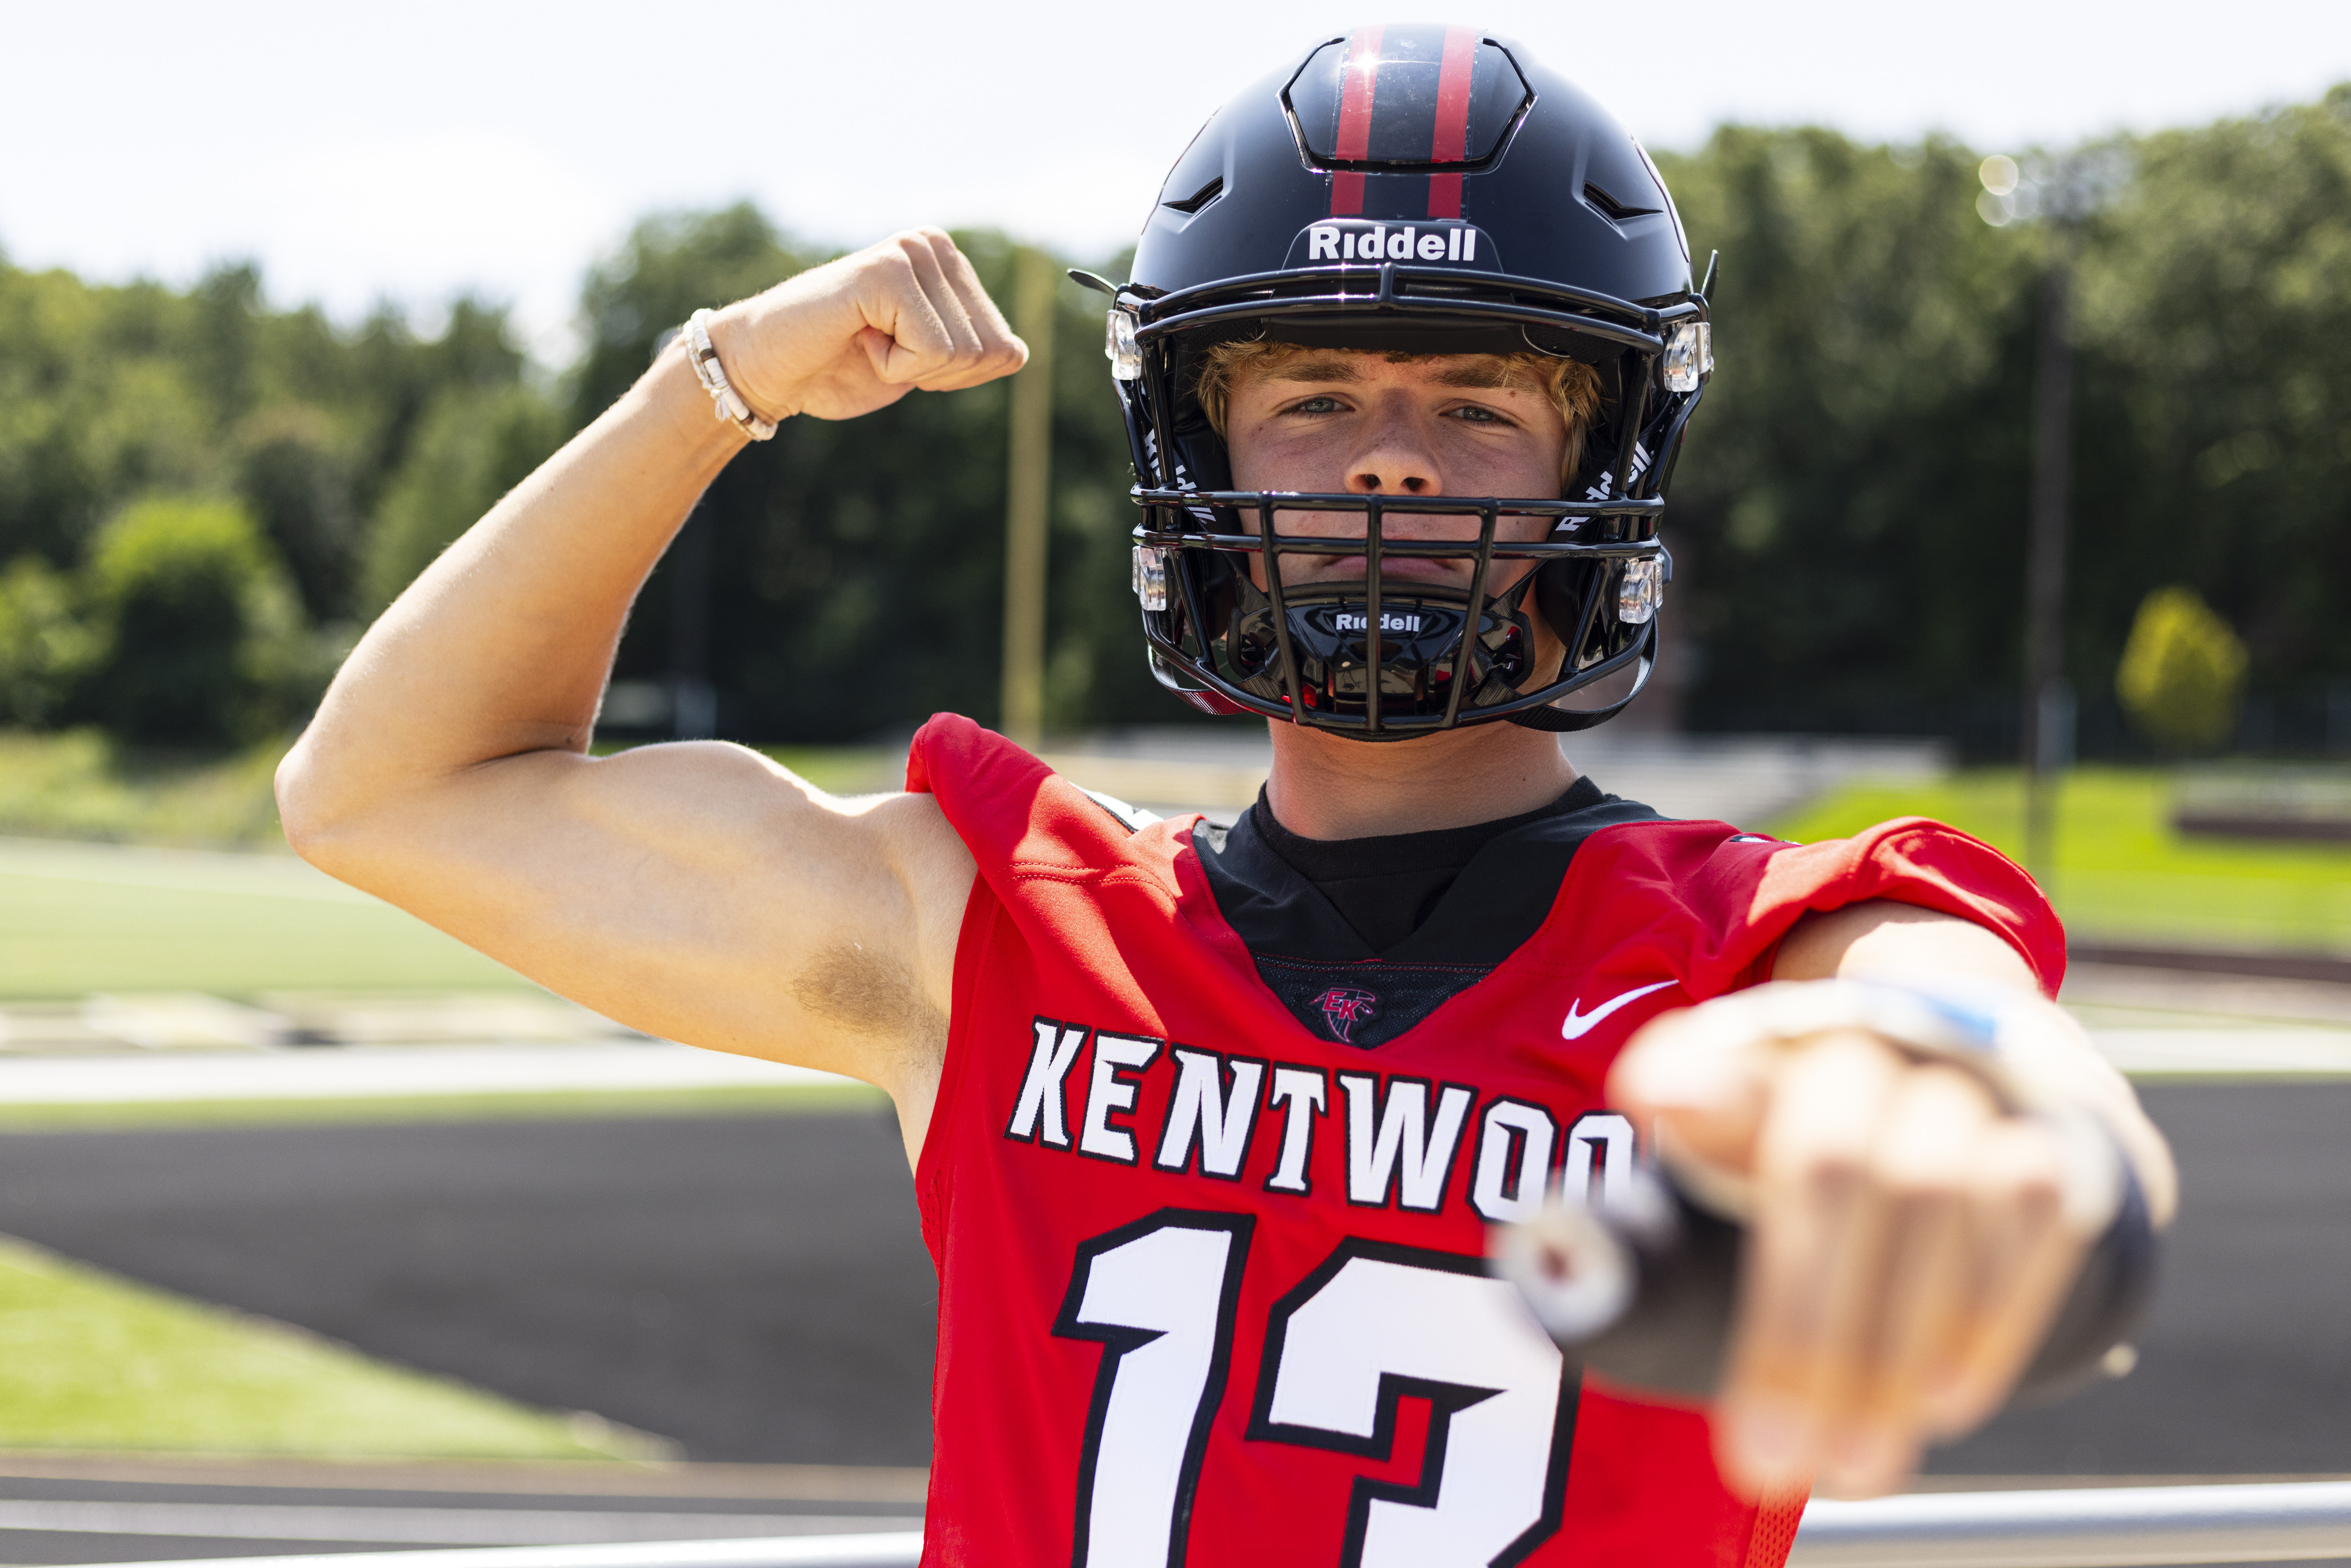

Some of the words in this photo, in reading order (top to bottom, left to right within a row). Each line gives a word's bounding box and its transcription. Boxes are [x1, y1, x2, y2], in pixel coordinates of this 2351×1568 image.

[1309, 226, 1476, 261] Riddell
[1145, 429, 1217, 522] Rddll
[1555, 441, 1652, 531] Rddell
[1322, 990, 1364, 1021] EK
[1005, 1016, 1645, 1226] KENTWOO
[1051, 1207, 1585, 1568] 13
